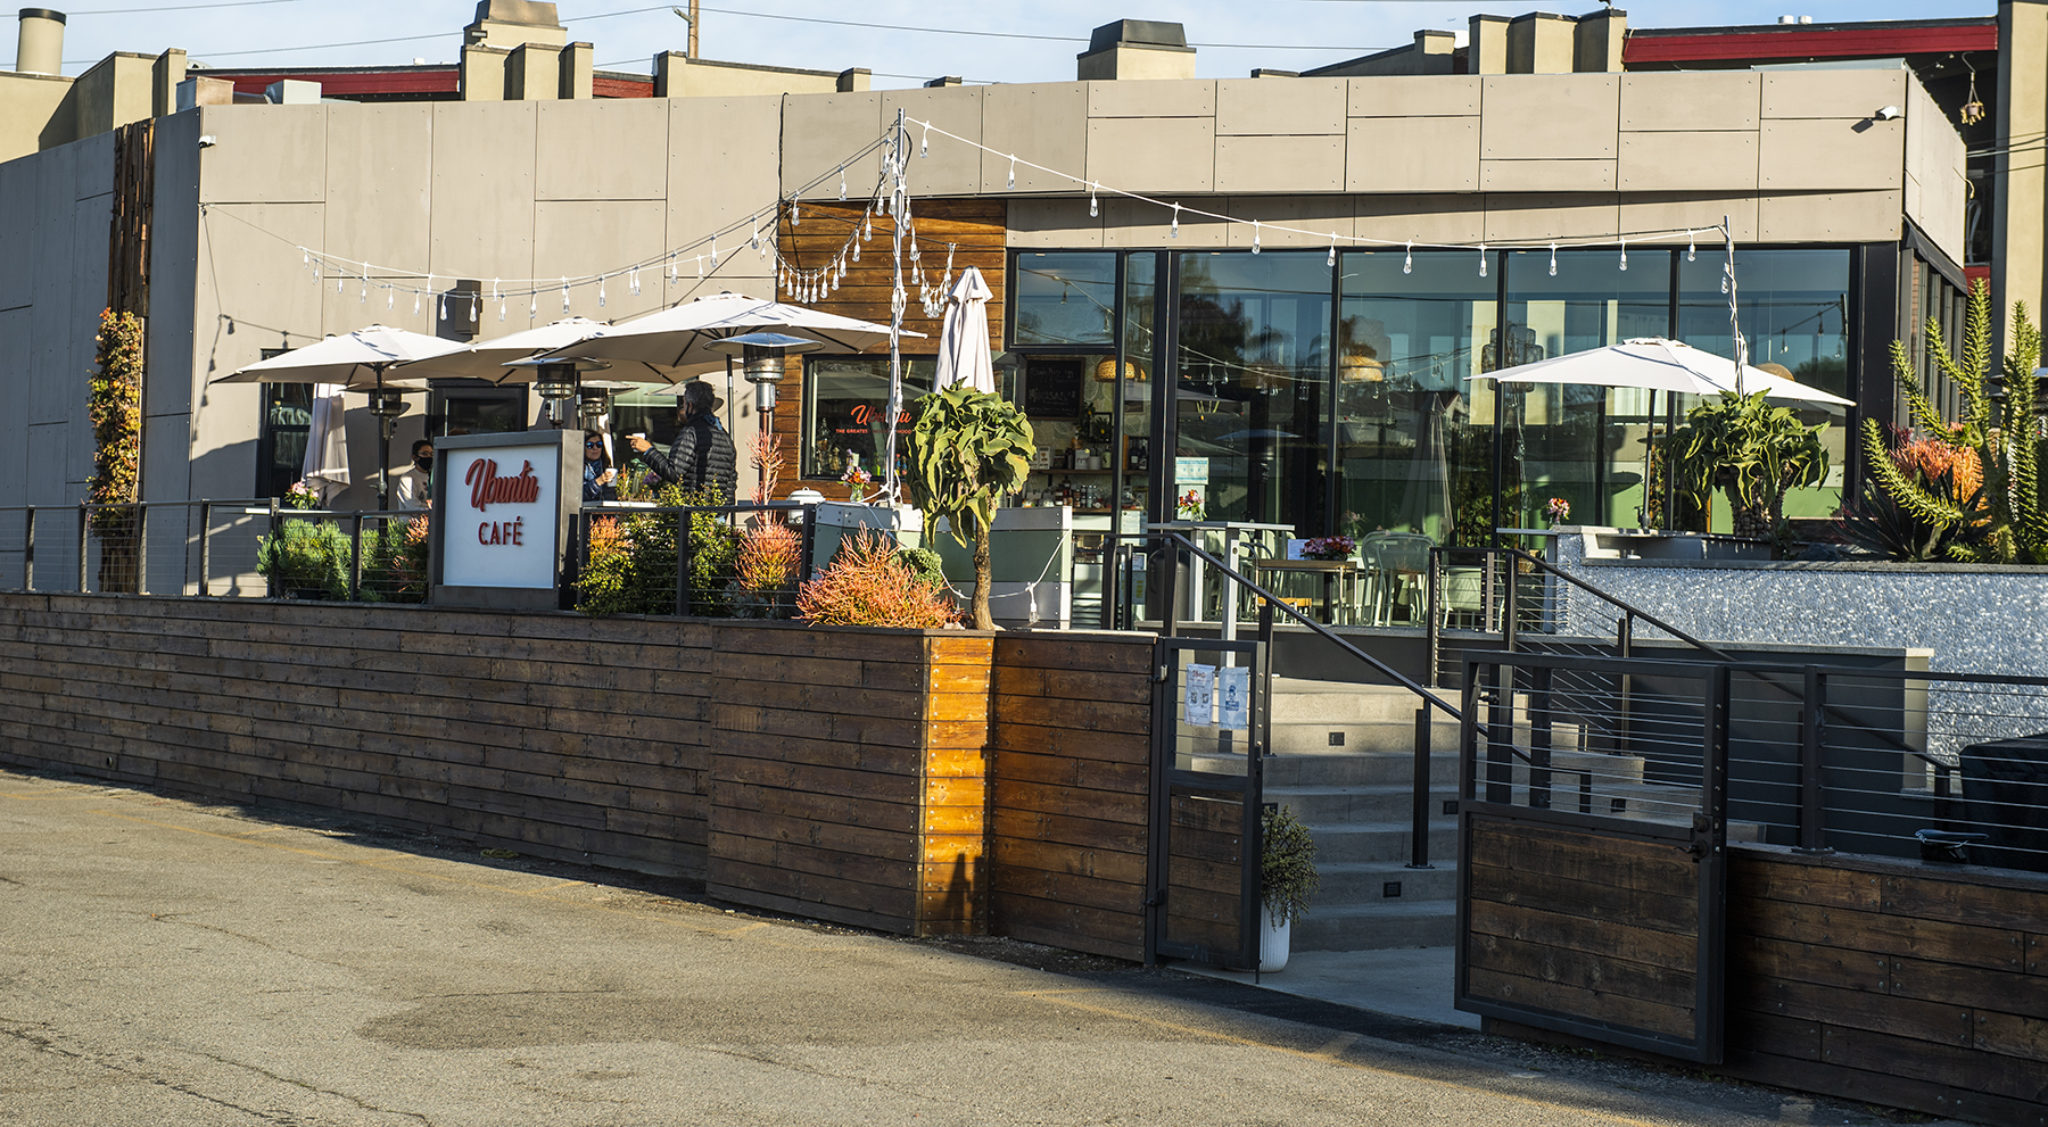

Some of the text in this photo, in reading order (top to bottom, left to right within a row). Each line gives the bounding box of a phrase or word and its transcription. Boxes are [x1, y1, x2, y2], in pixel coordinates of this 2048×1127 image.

[850, 404, 912, 426] Ubuu
[465, 458, 539, 512] Ubuntu
[478, 516, 524, 546] CAFÉ
